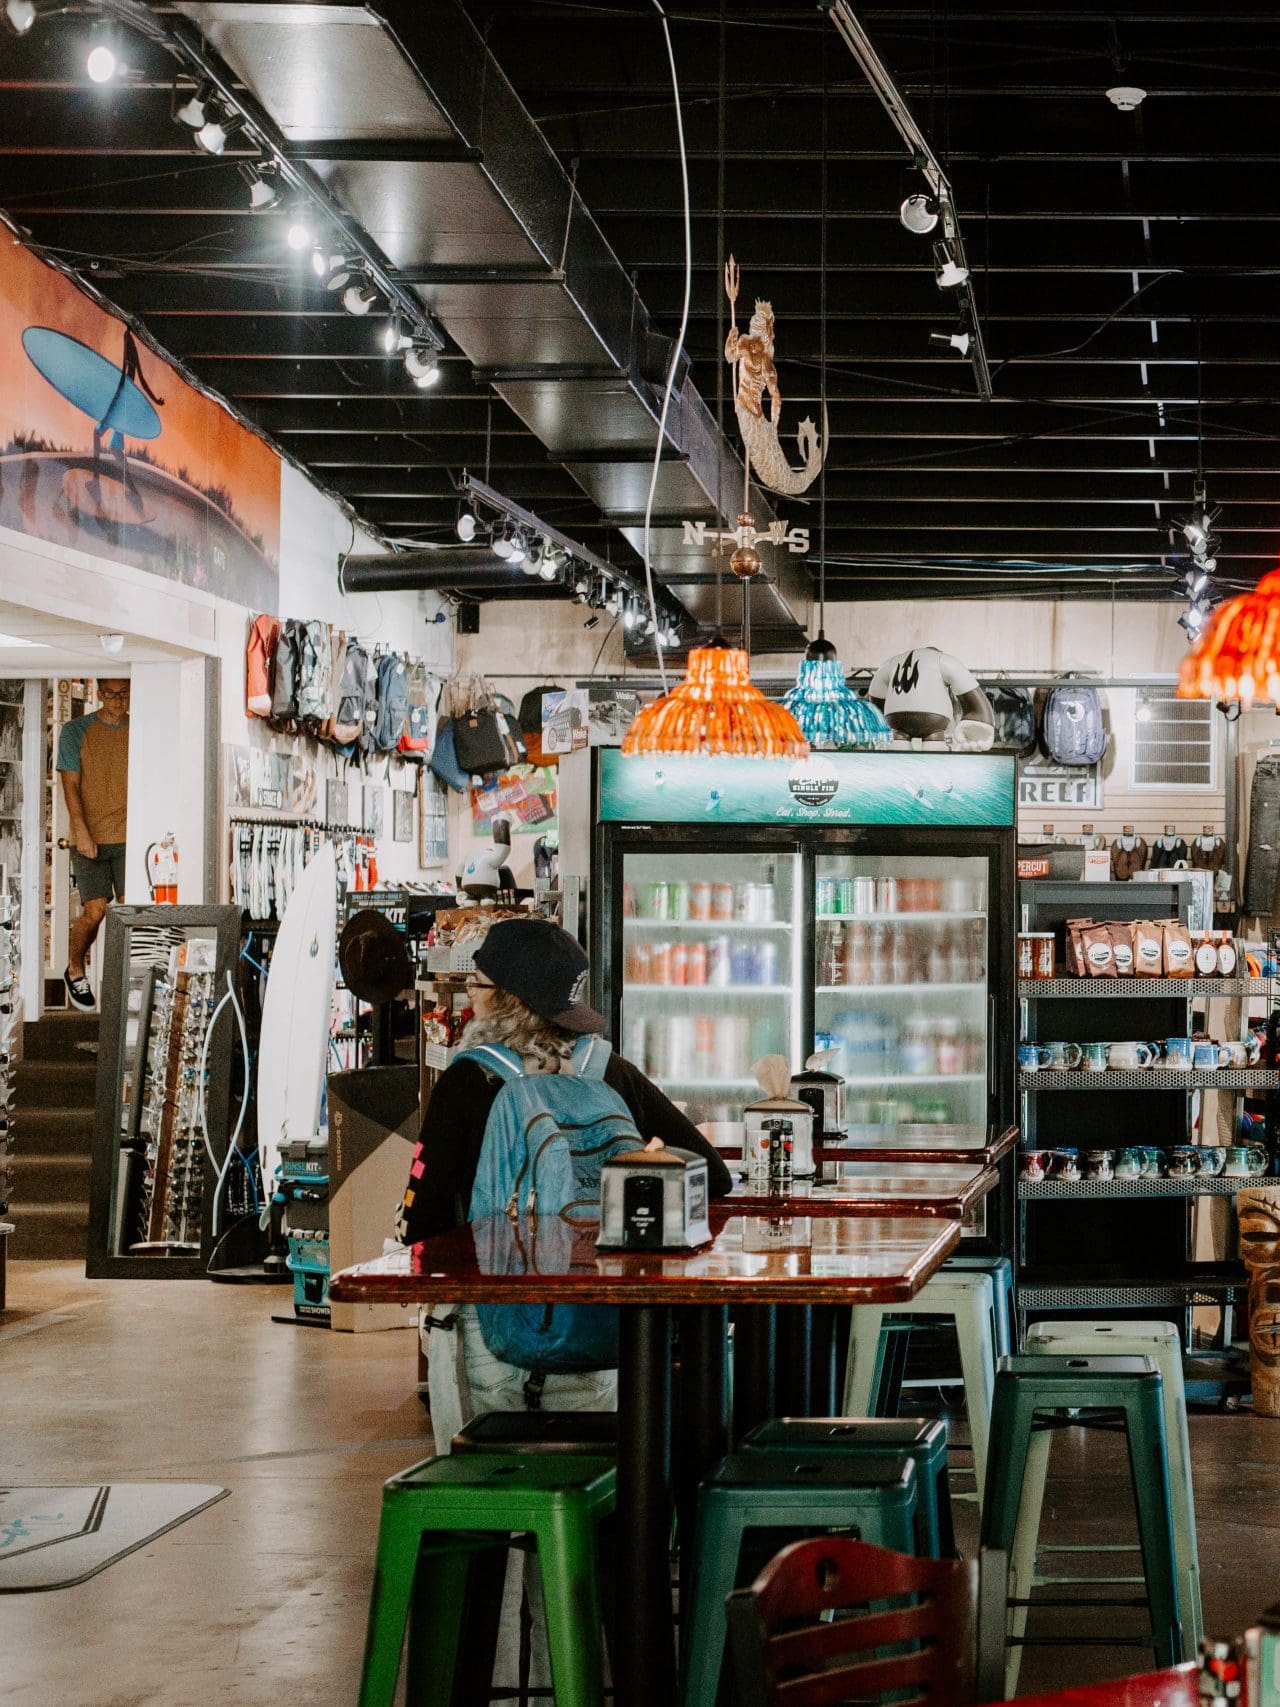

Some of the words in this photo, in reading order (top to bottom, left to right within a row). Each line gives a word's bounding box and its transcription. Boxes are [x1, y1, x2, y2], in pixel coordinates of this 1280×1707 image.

[682, 521, 706, 545] N
[769, 520, 789, 545] W
[788, 528, 810, 553] S
[1020, 782, 1088, 802] REEF
